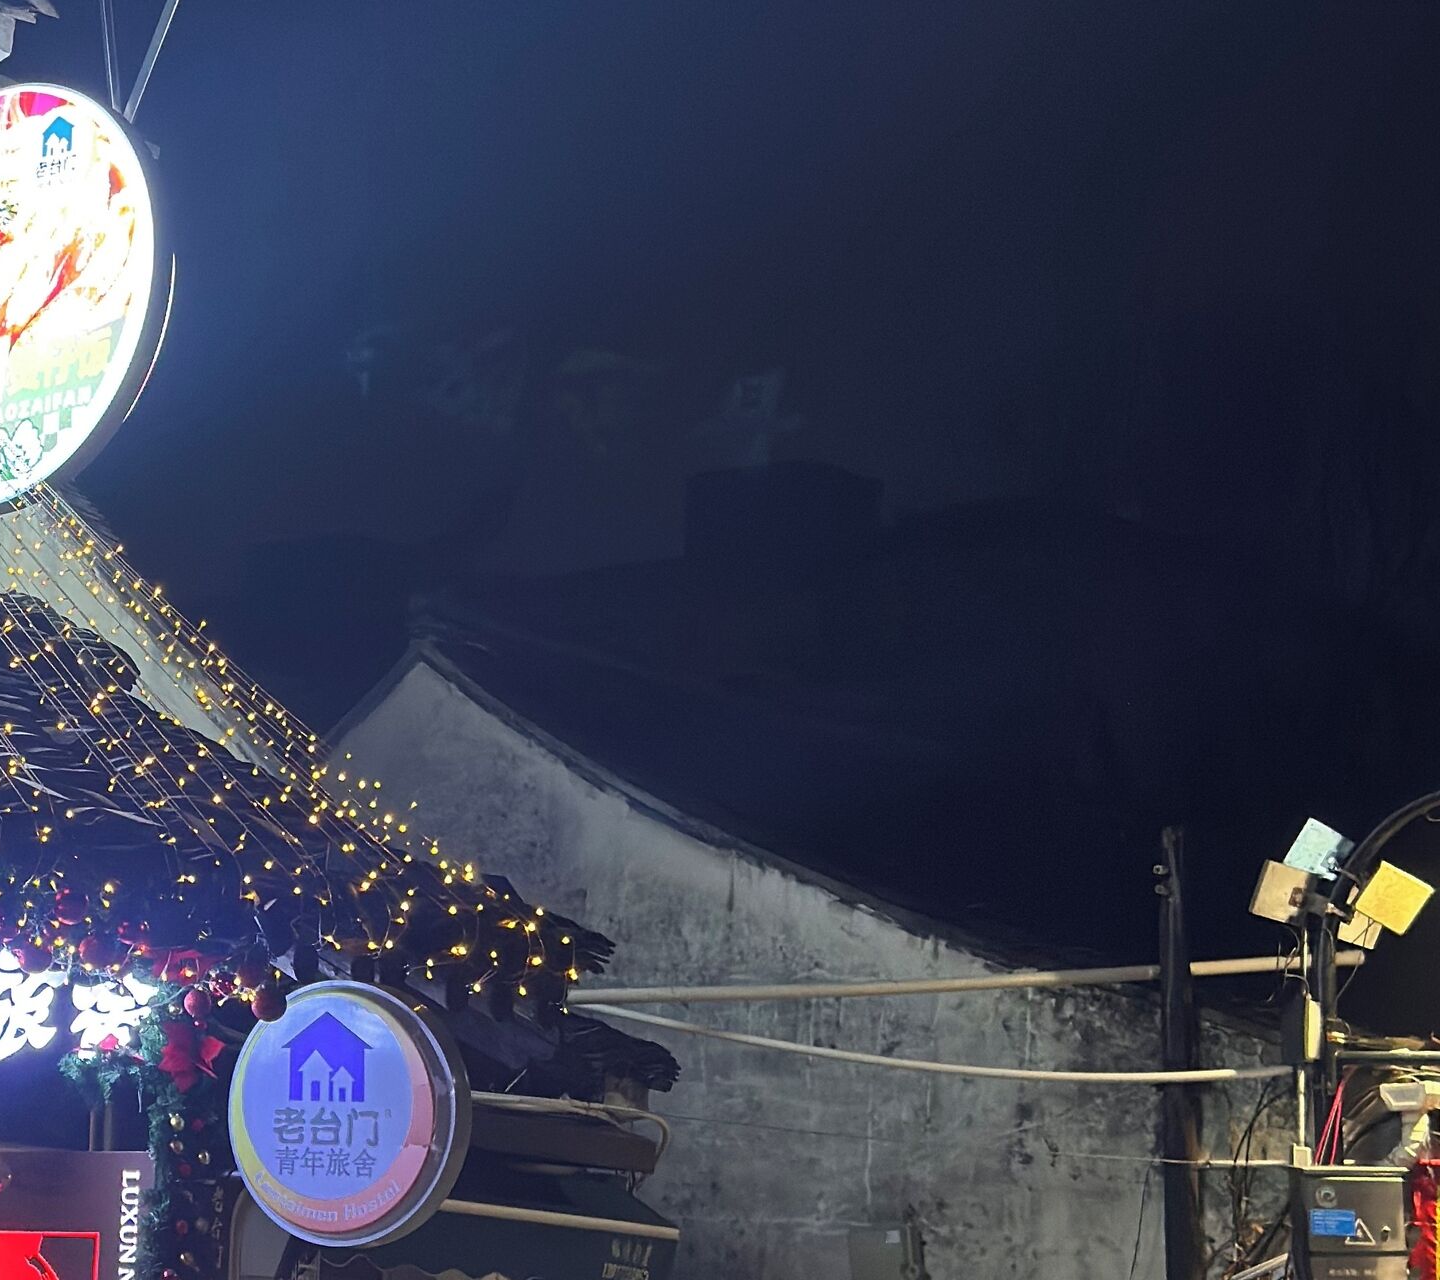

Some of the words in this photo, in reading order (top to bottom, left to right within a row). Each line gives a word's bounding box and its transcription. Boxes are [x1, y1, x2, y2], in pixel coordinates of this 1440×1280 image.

[273, 1107, 379, 1148] 老台门
[275, 1146, 377, 1179] 青年旅舍
[117, 1168, 141, 1263] LUXUN
